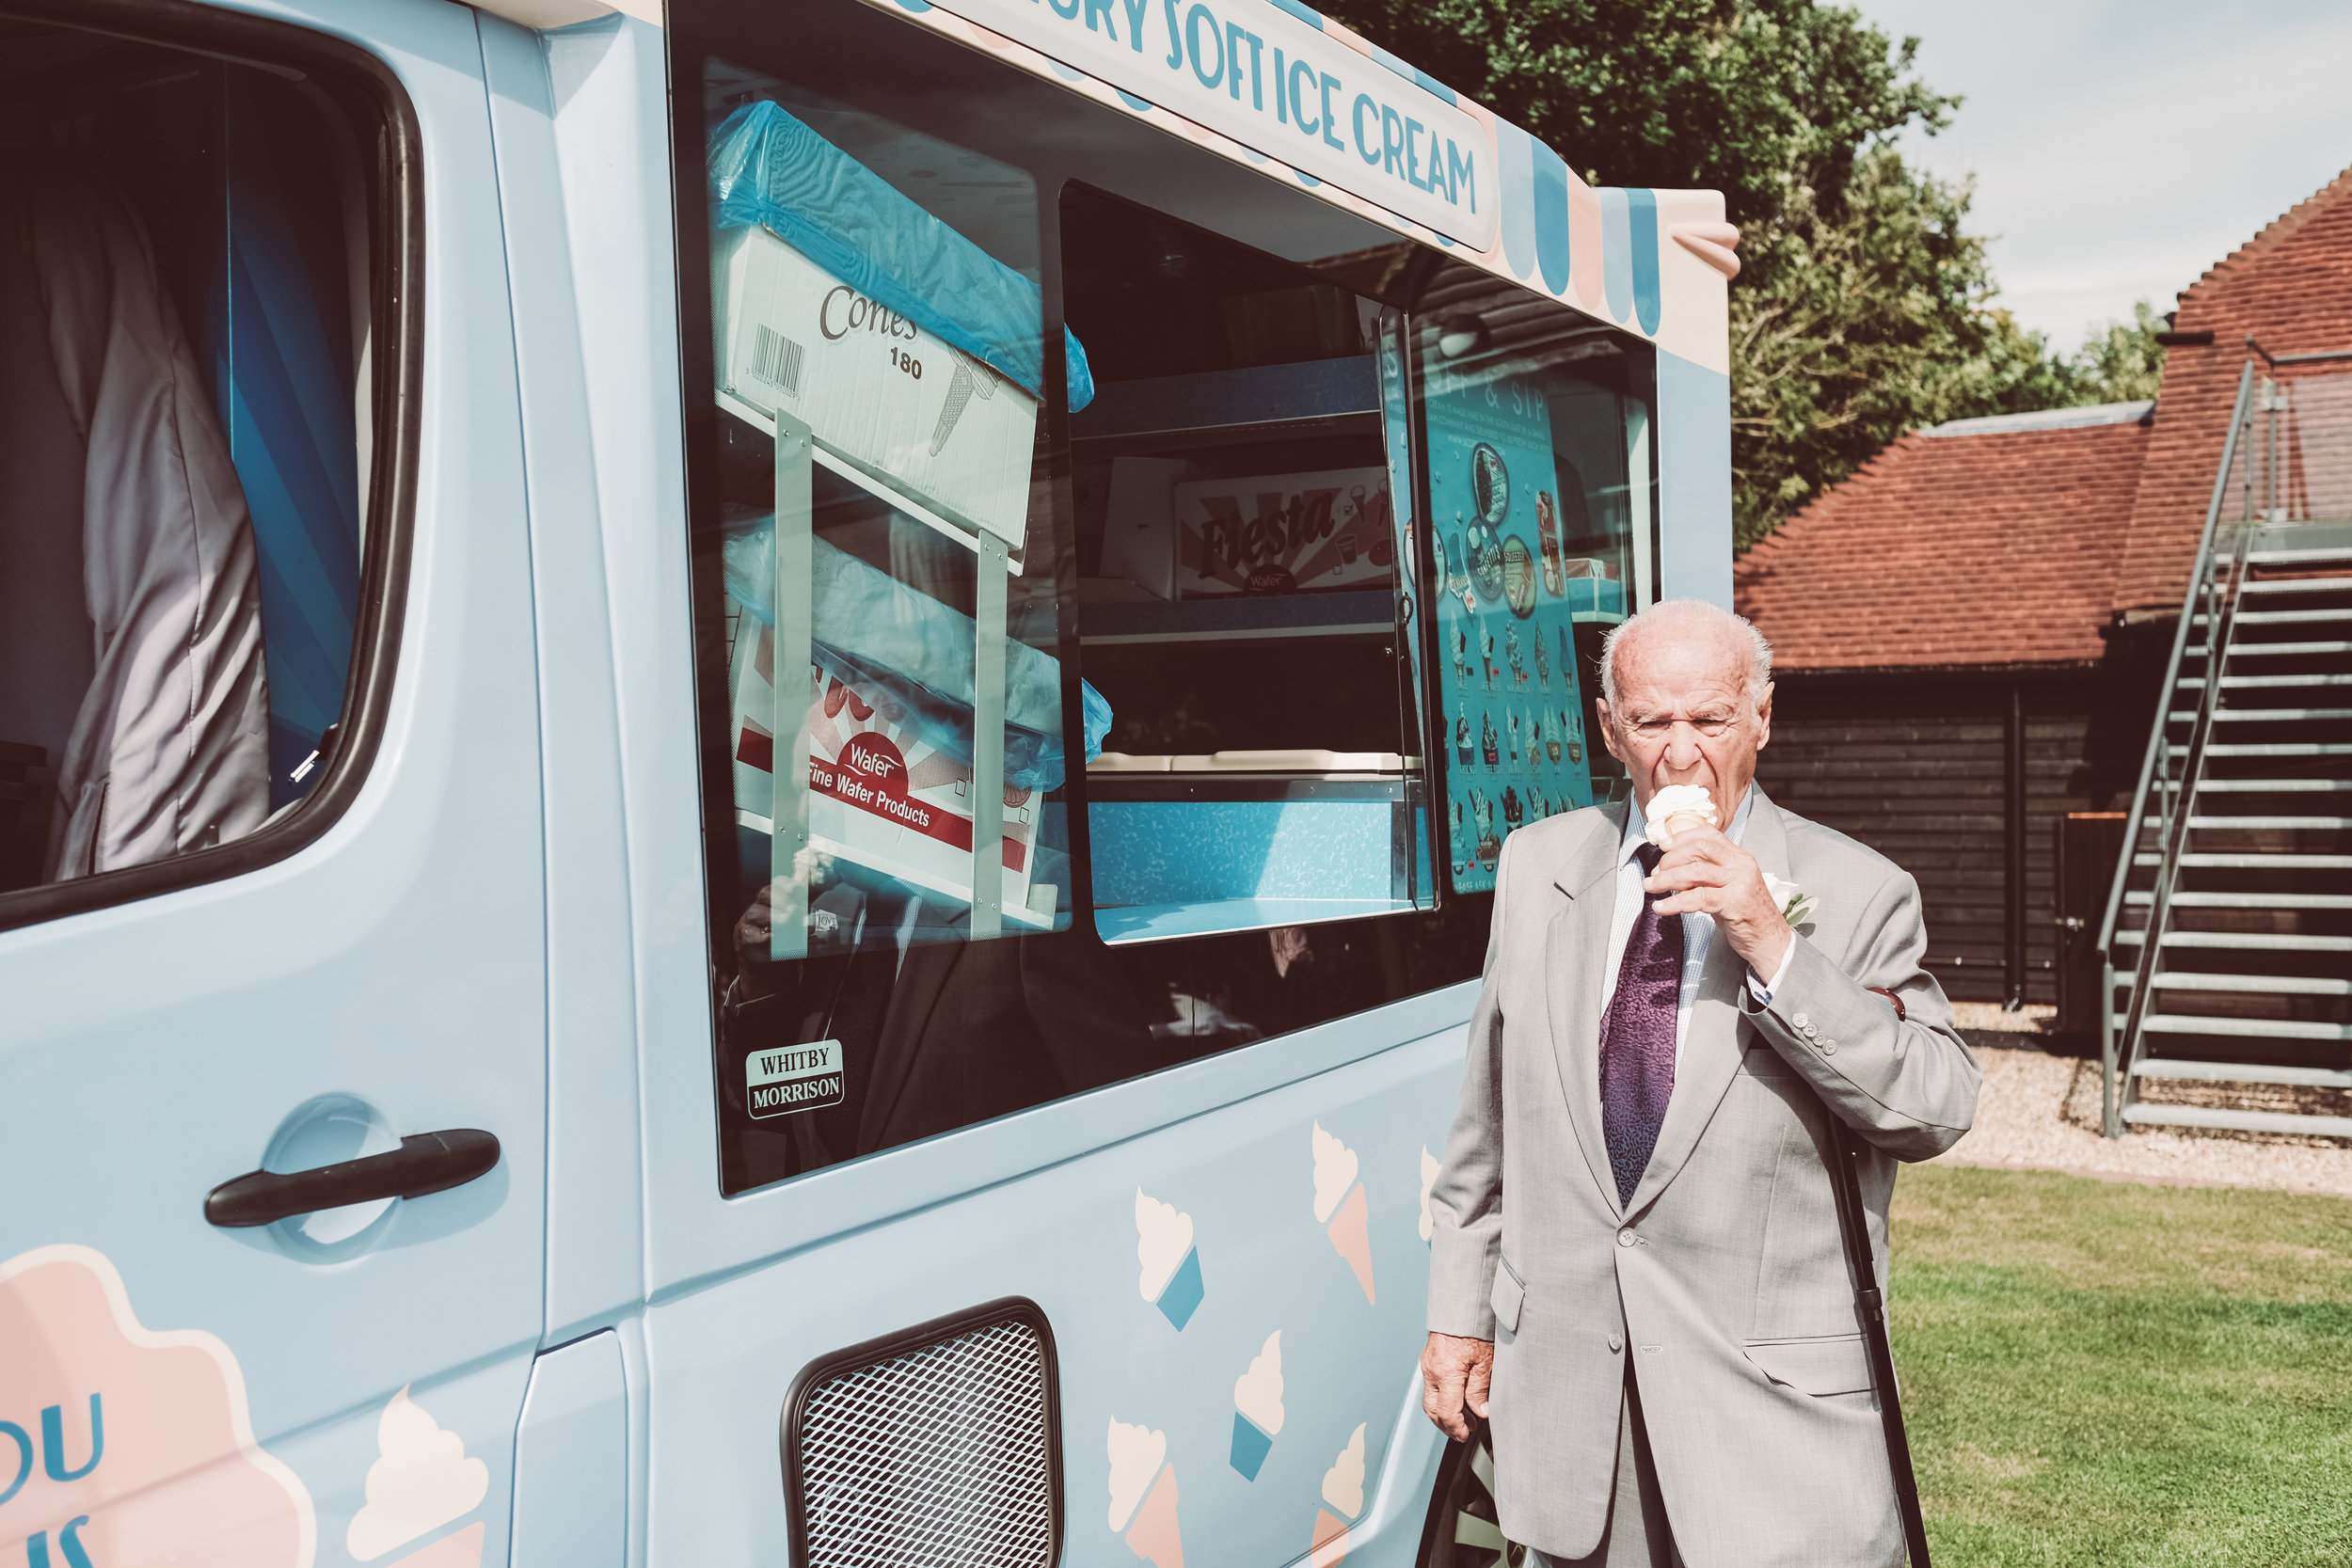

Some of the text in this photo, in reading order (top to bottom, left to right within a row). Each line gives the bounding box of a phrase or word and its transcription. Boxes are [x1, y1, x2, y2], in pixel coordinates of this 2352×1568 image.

[1165, 0, 1263, 112] SOFT
[1274, 47, 1345, 152] ICE
[1353, 93, 1476, 215] CREAM
[819, 285, 917, 341] Cones
[890, 346, 922, 380] 180
[1199, 492, 1335, 579] Fiesta
[1250, 575, 1281, 588] Wafer
[851, 743, 891, 779] Wafer
[836, 772, 875, 804] Wafer
[876, 790, 930, 827] Products
[760, 1047, 830, 1075] WHITBY
[754, 1077, 840, 1109] MORRISON
